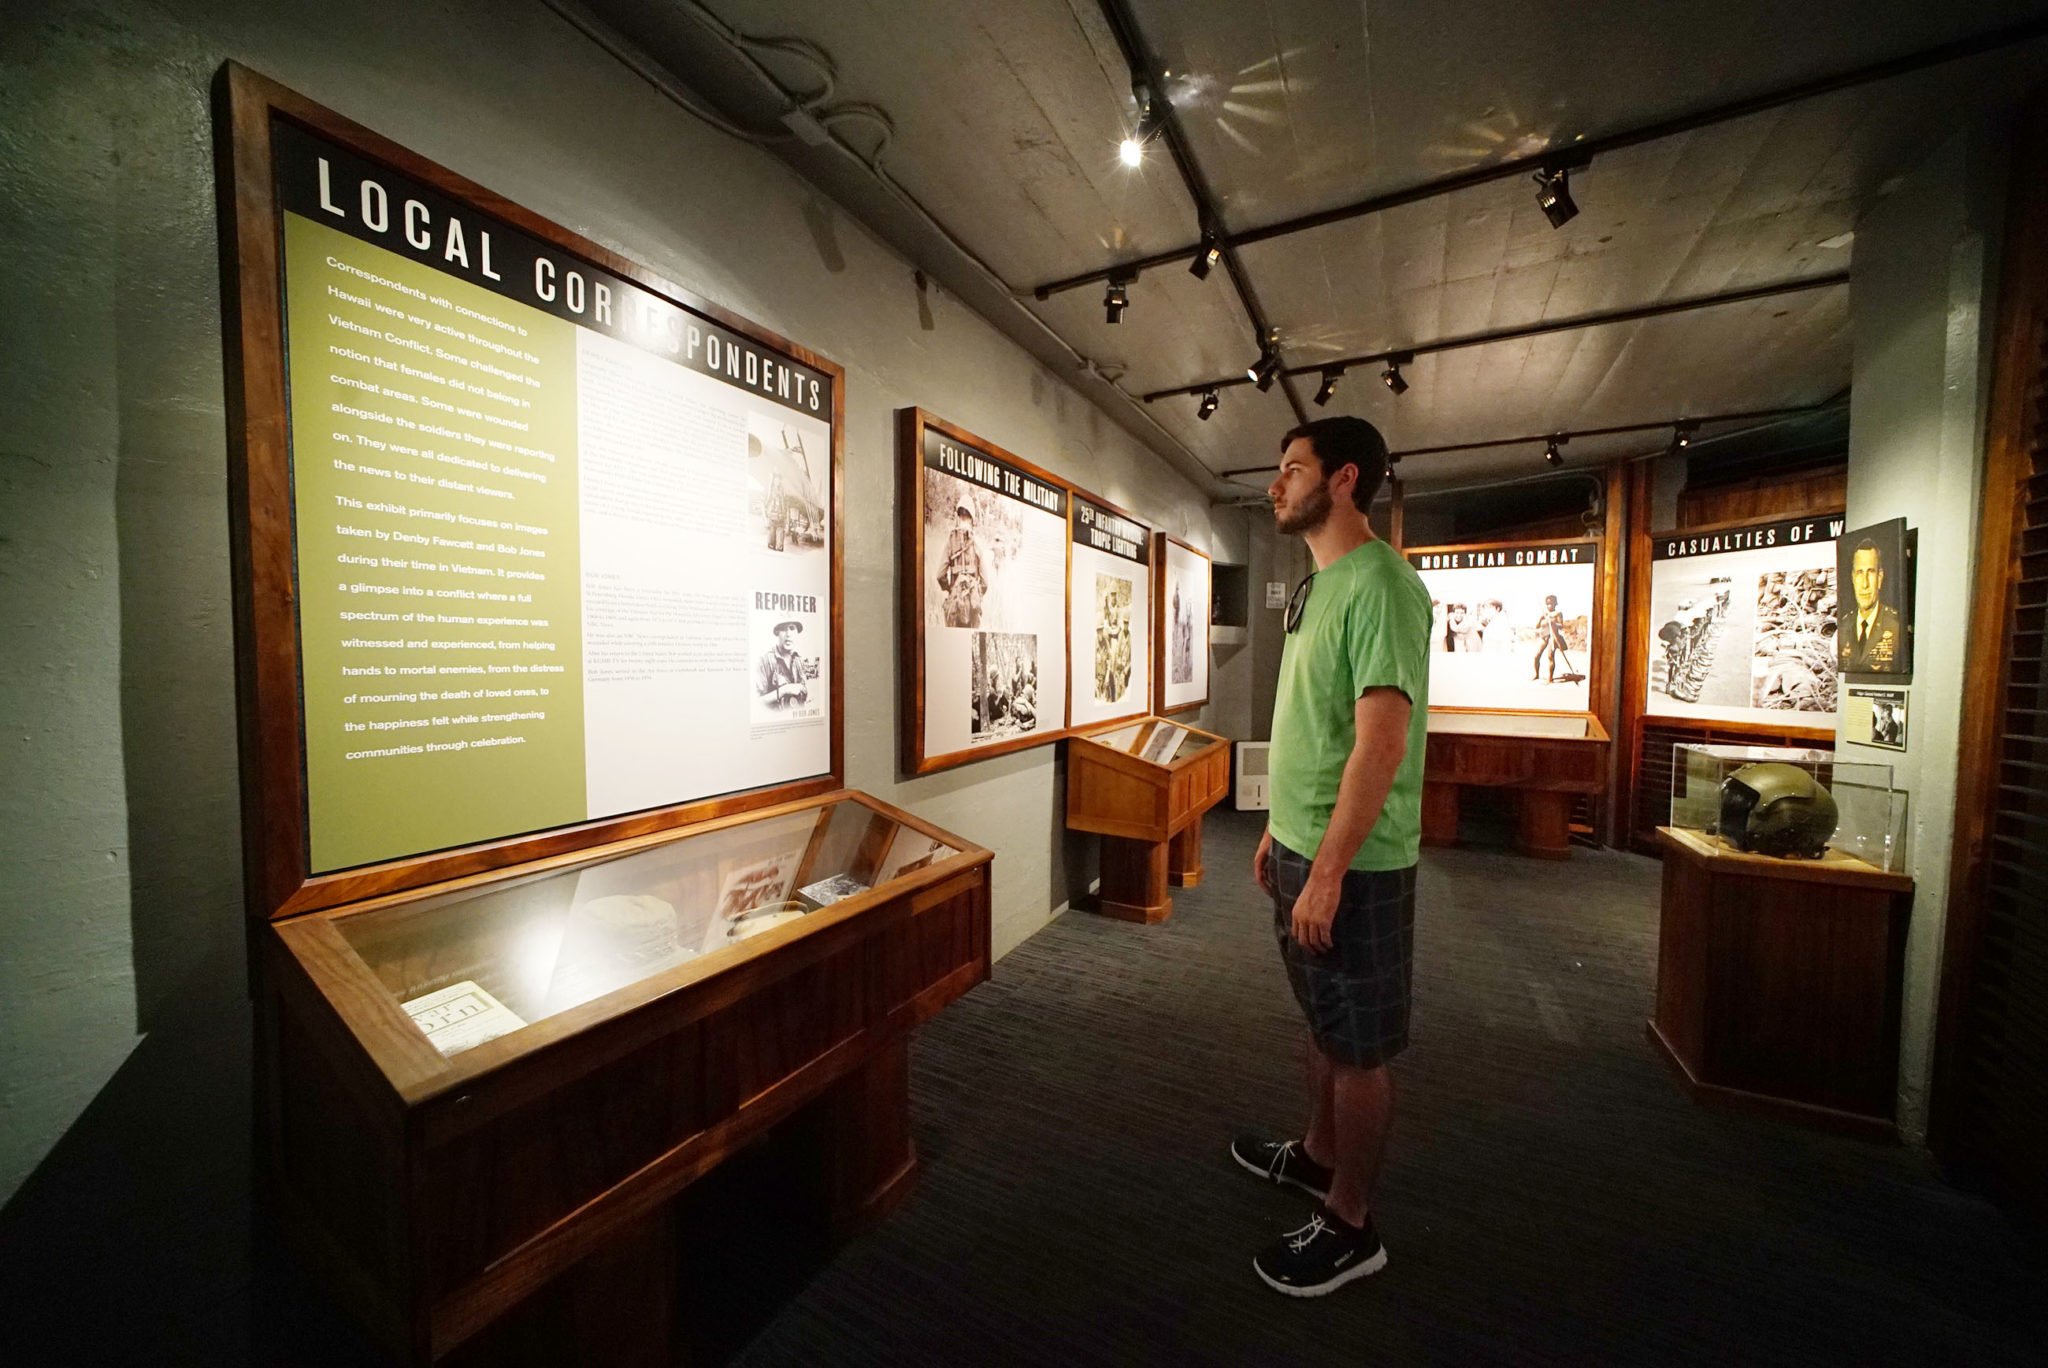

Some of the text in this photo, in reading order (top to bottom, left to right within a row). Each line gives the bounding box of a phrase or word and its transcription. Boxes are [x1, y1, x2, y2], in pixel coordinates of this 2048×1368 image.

[318, 157, 820, 411] LOCAL CORRESPONDENTS
[326, 256, 527, 337] Correspondents with connections to
[327, 284, 539, 365] Hawaii were very active throughout the
[328, 313, 540, 388] Vietnam Conflict. Some challenged the
[329, 345, 530, 409] notion that females did not belong in
[330, 374, 528, 432] combat areas. Some were wounded
[331, 402, 555, 463] alongside the soldiers they were reporting
[332, 432, 546, 484] on. They were all dedicated to delivering
[333, 459, 514, 500] the news to their distant viewers.
[939, 444, 1059, 512] FOLLOWING THE MILITARY
[334, 495, 548, 536] This exhibit primarily focuses on images
[335, 524, 545, 558] taken by Denby Fawcett and Bob Jones
[1668, 528, 1776, 557] CASUALTIES
[1790, 524, 1814, 542] OF
[336, 553, 545, 581] during their time in Vietnam. It provides
[1421, 549, 1579, 569] MORE THAN COMBAT
[338, 582, 532, 603] a glimpse into a conflict where a full
[755, 591, 816, 613] REPORTER
[339, 611, 549, 627] spectrum of the human experience was
[341, 638, 555, 652] witnessed and experienced, from helping
[341, 663, 563, 676] hands to mortal enemies, from the distress
[343, 687, 549, 704] of mourning the death of loved ones, to
[344, 711, 545, 732] the happiness felt while strengthening
[345, 735, 525, 760] communities through celebration.
